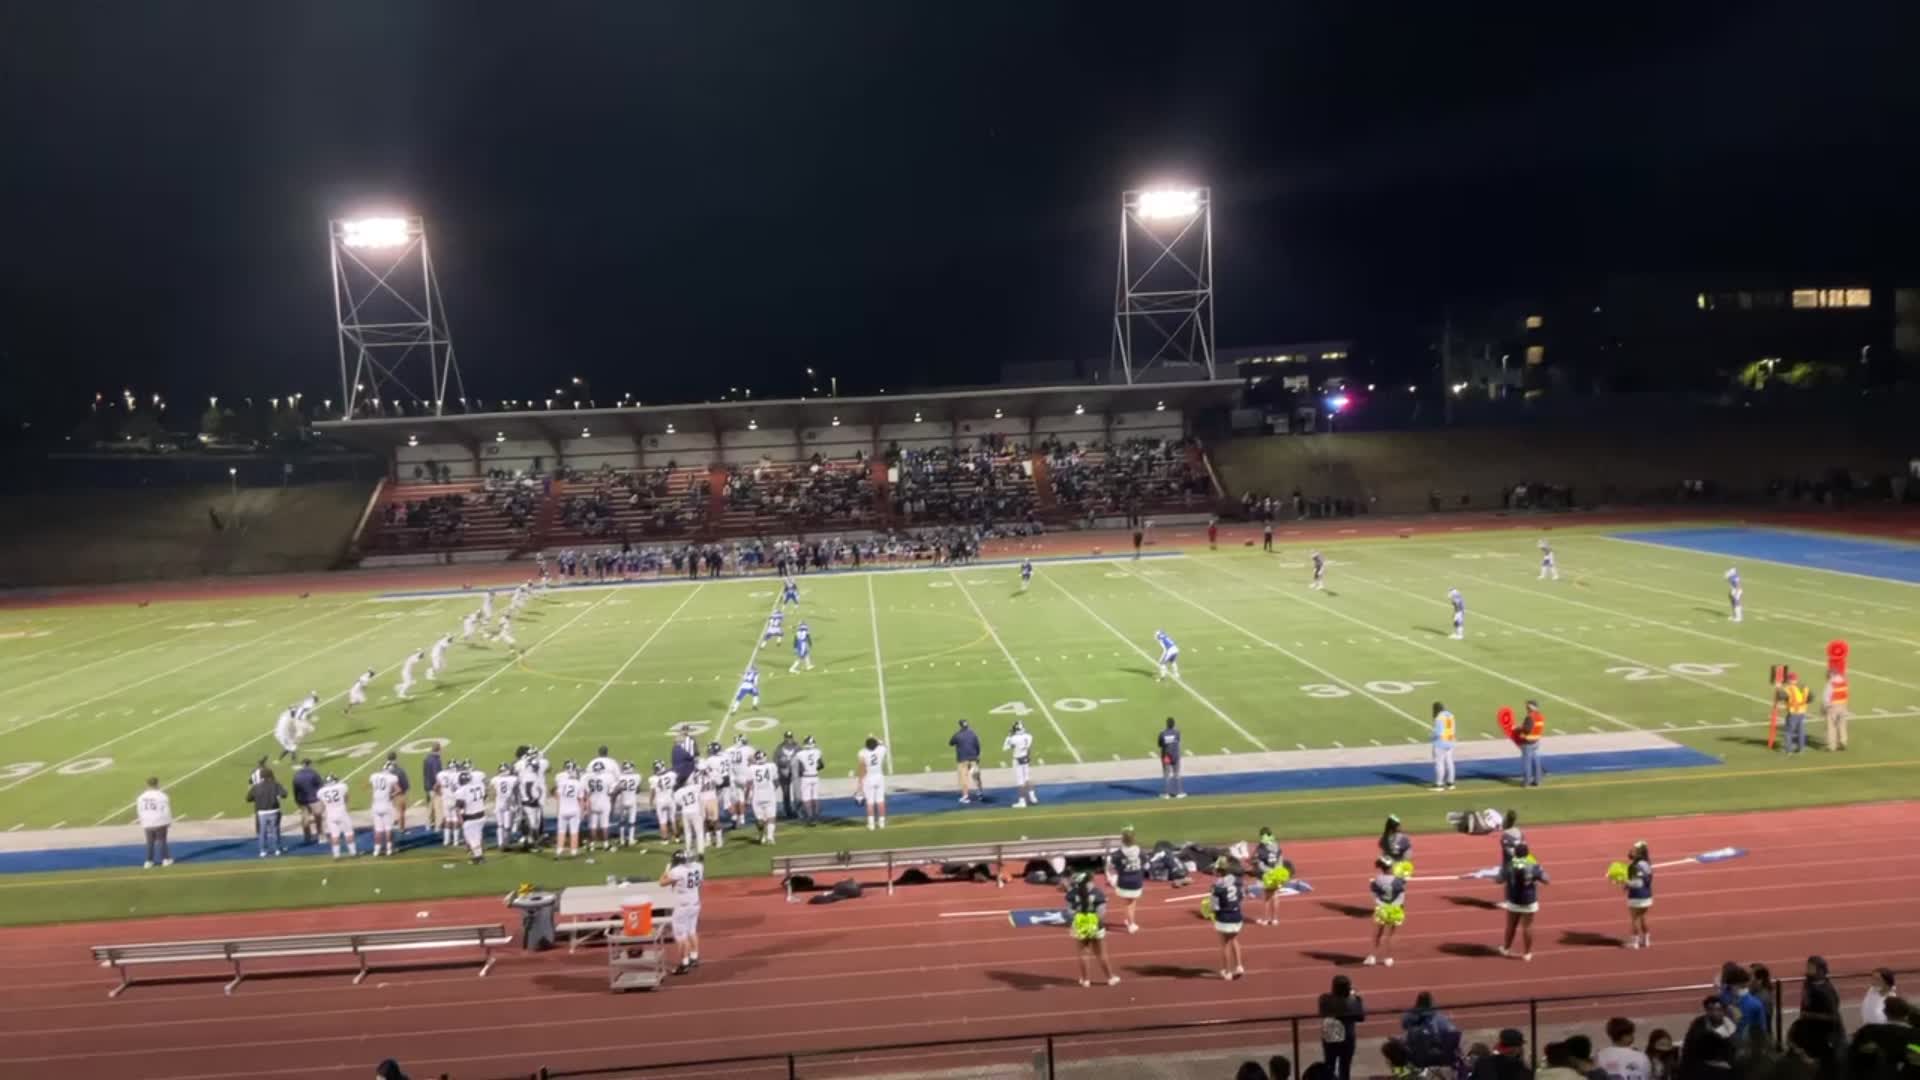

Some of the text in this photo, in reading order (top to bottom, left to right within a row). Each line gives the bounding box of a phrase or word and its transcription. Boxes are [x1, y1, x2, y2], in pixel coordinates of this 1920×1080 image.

[1604, 663, 1724, 680] 20
[1299, 678, 1415, 699] 30
[988, 698, 1098, 716] 40
[870, 754, 878, 766] 2
[755, 769, 770, 782] 54
[324, 788, 340, 803] 52
[682, 791, 697, 807] 13
[1227, 885, 1238, 901] 2
